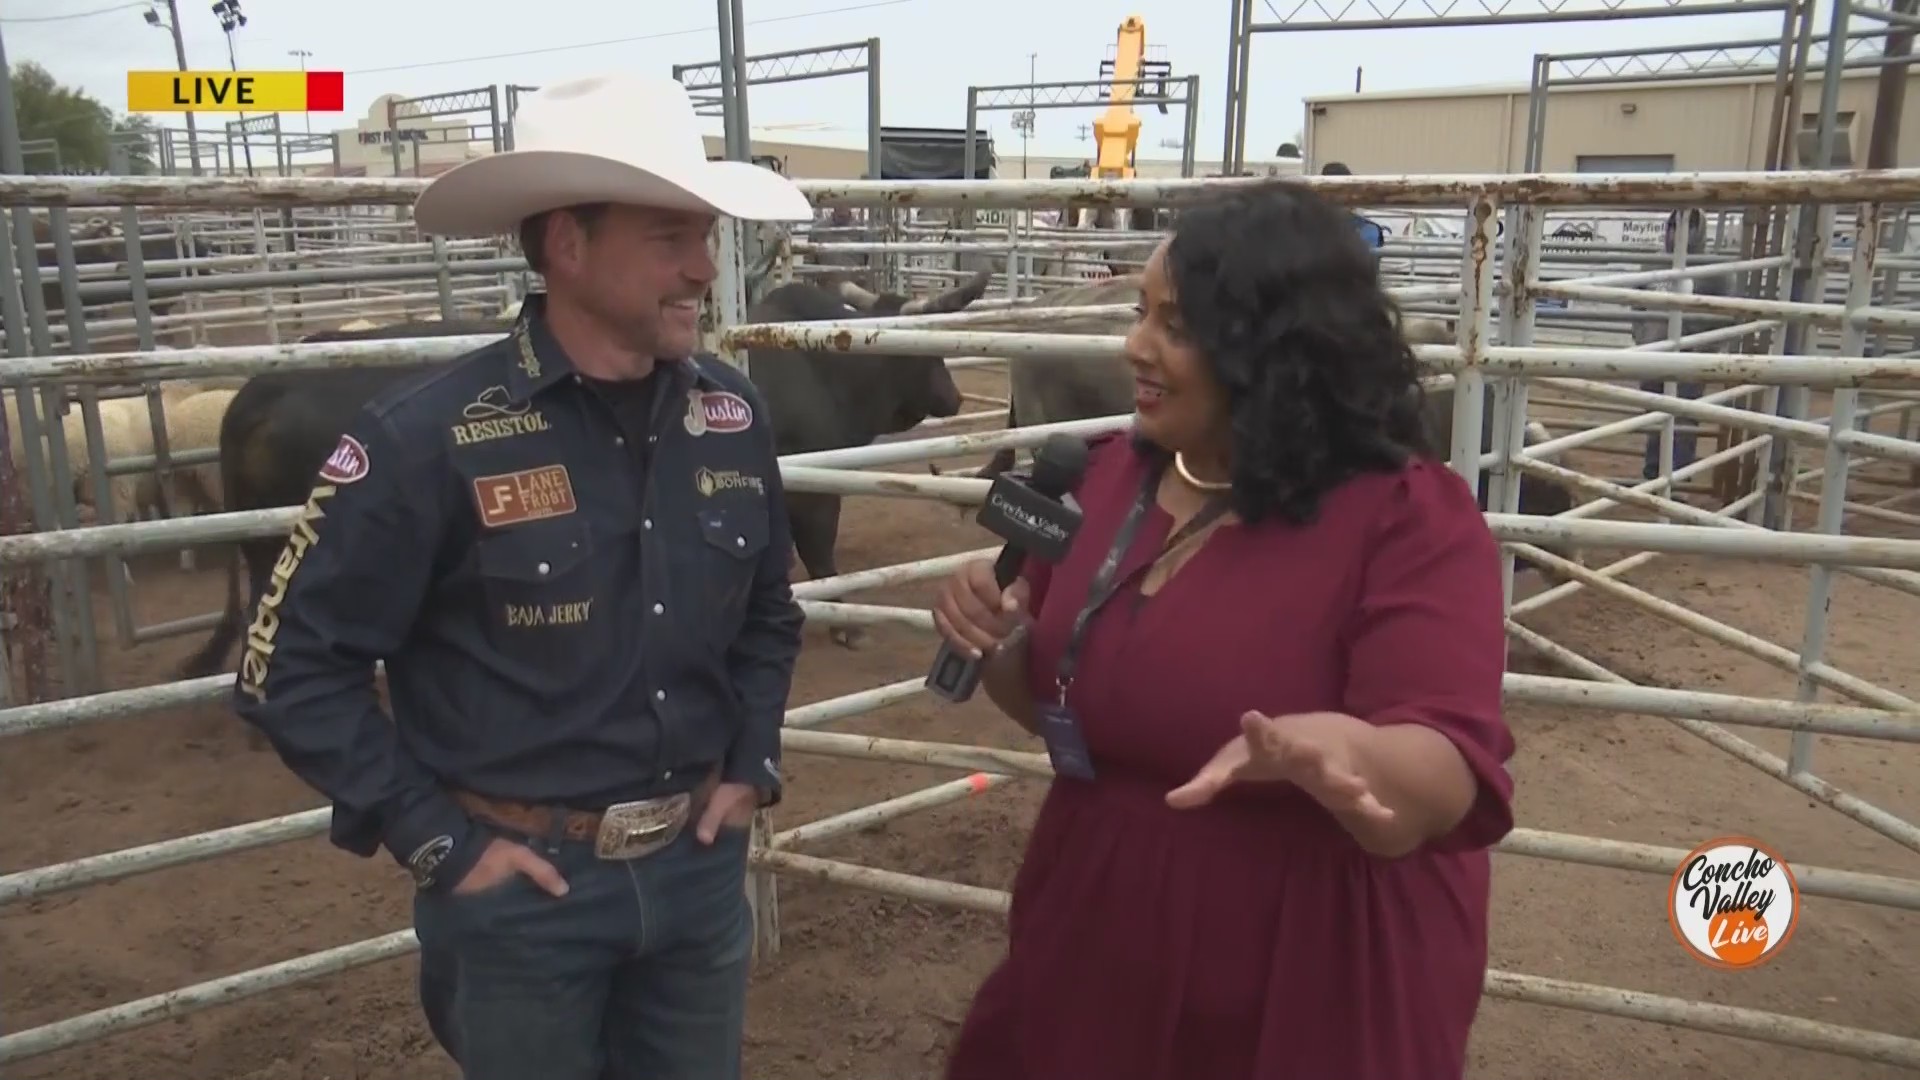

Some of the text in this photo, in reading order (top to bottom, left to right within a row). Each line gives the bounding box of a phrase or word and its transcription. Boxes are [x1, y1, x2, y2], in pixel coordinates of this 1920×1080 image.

[1623, 221, 1666, 234] Mayfiel
[683, 388, 749, 437] Justin
[451, 411, 549, 445] RESISTOL
[326, 443, 361, 476] stin
[514, 471, 564, 495] LANE
[506, 600, 592, 627] BAJA JERKY
